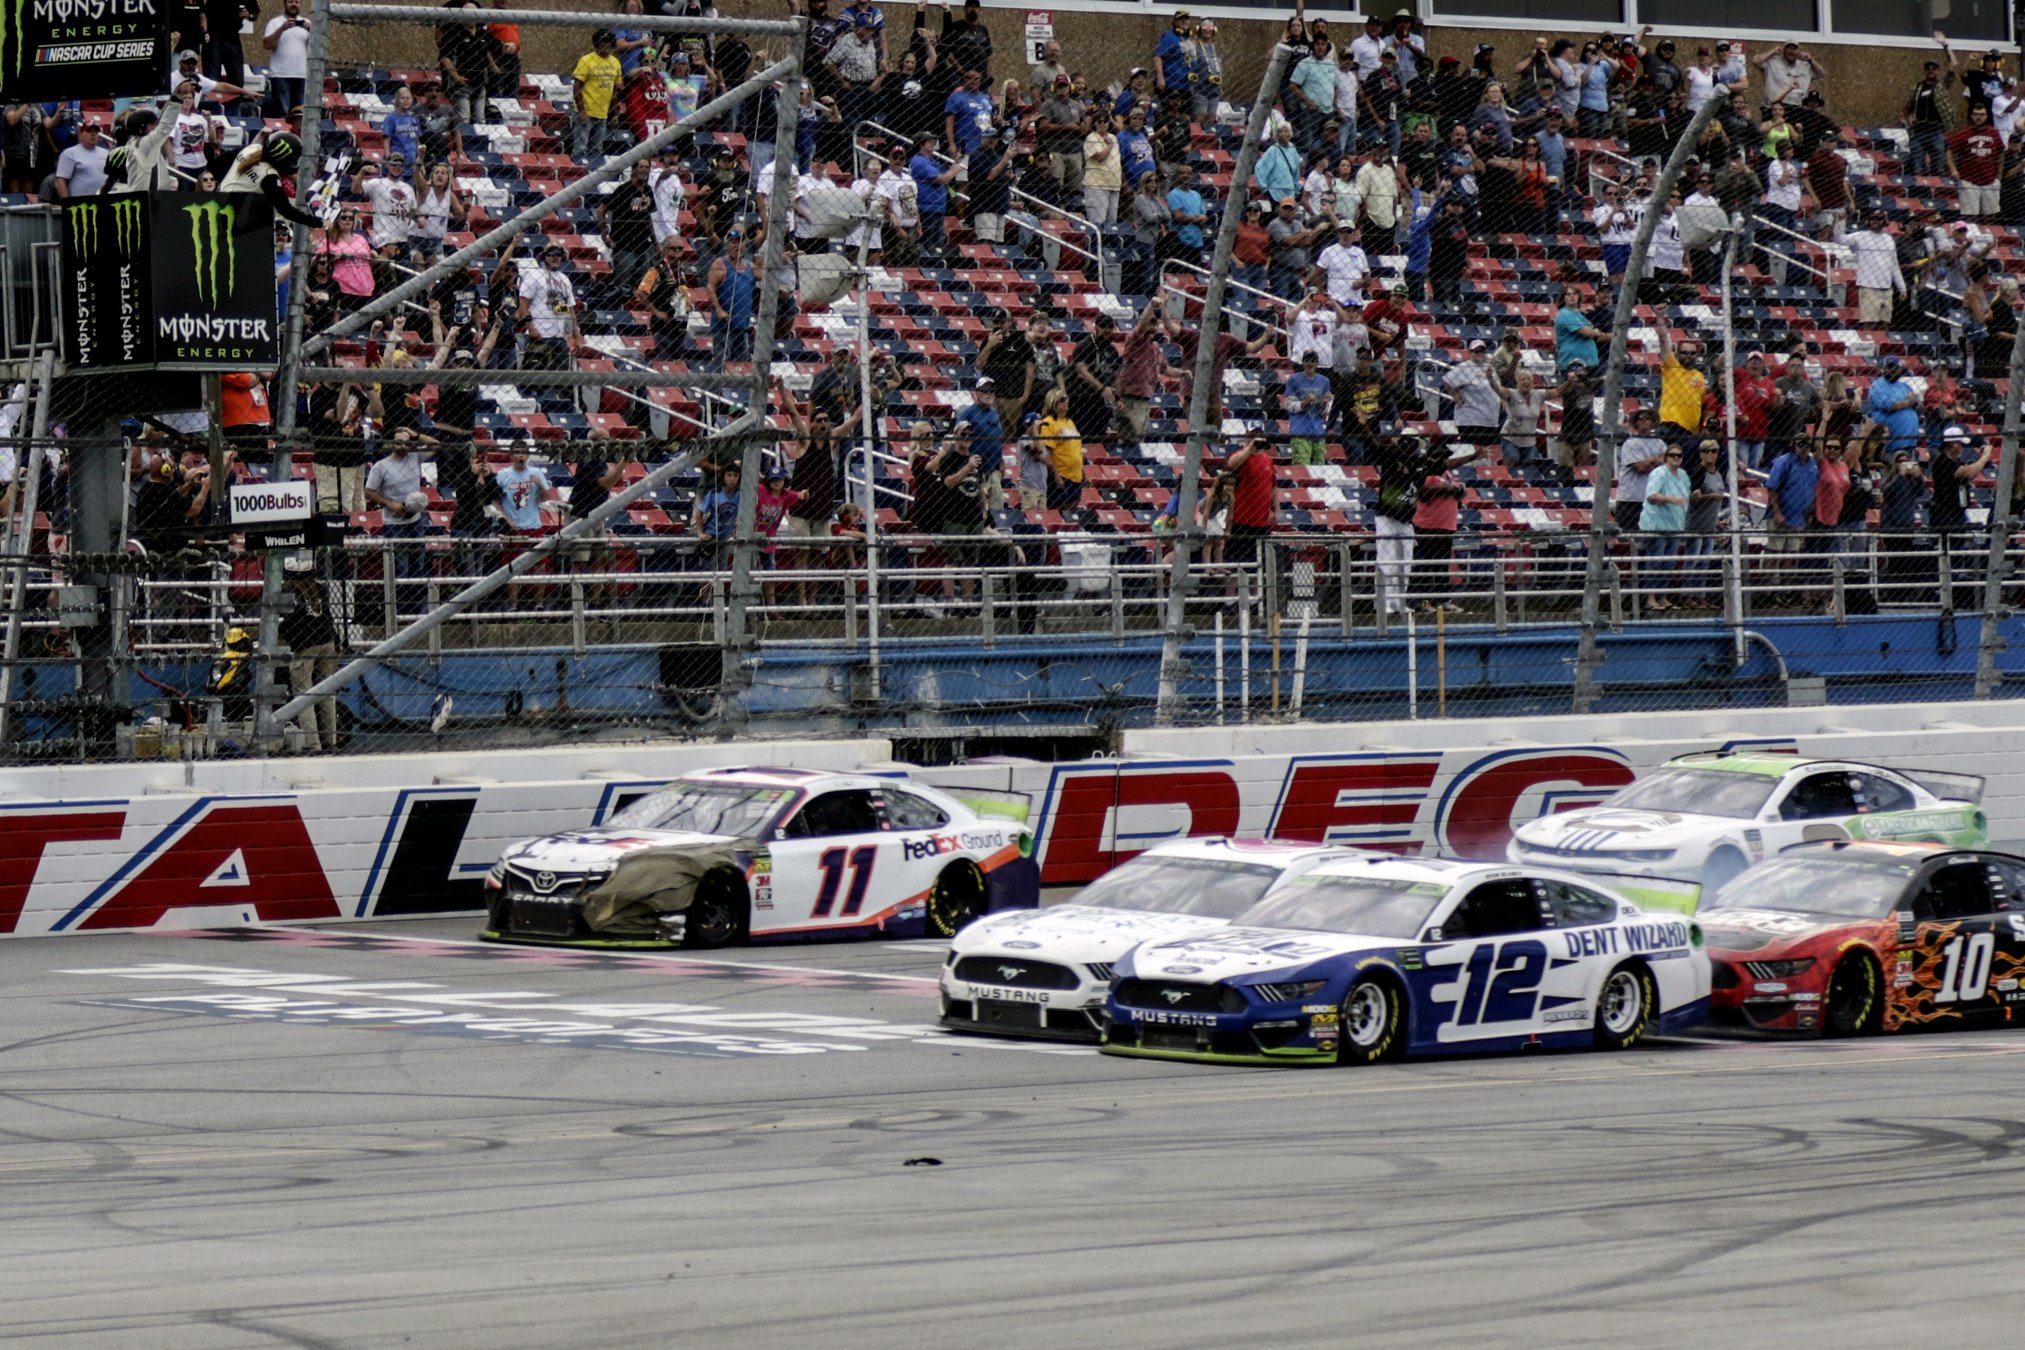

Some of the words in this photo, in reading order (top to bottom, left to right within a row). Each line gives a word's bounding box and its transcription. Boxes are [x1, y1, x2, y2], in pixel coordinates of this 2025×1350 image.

[34, 0, 156, 23] MONSTER
[52, 24, 137, 39] ENERGY
[49, 45, 92, 62] NASCAR
[93, 43, 116, 59] CUP
[116, 42, 154, 58] SERIES
[76, 267, 90, 364] MONSTER
[120, 263, 134, 360] MONSTER
[159, 313, 270, 343] MONSTER
[177, 348, 254, 358] ENERGY
[901, 833, 963, 861] FedEx
[961, 830, 1003, 849] Ground
[809, 844, 879, 919] 11
[513, 894, 574, 904] CAMRY
[1563, 927, 1619, 958] DENT
[1624, 922, 1688, 952] WIZARD
[1934, 932, 1995, 1003] 10
[968, 986, 1051, 1003] MUSTANG
[1457, 939, 1547, 1027] 12
[1131, 1010, 1218, 1027] MUSTANG
